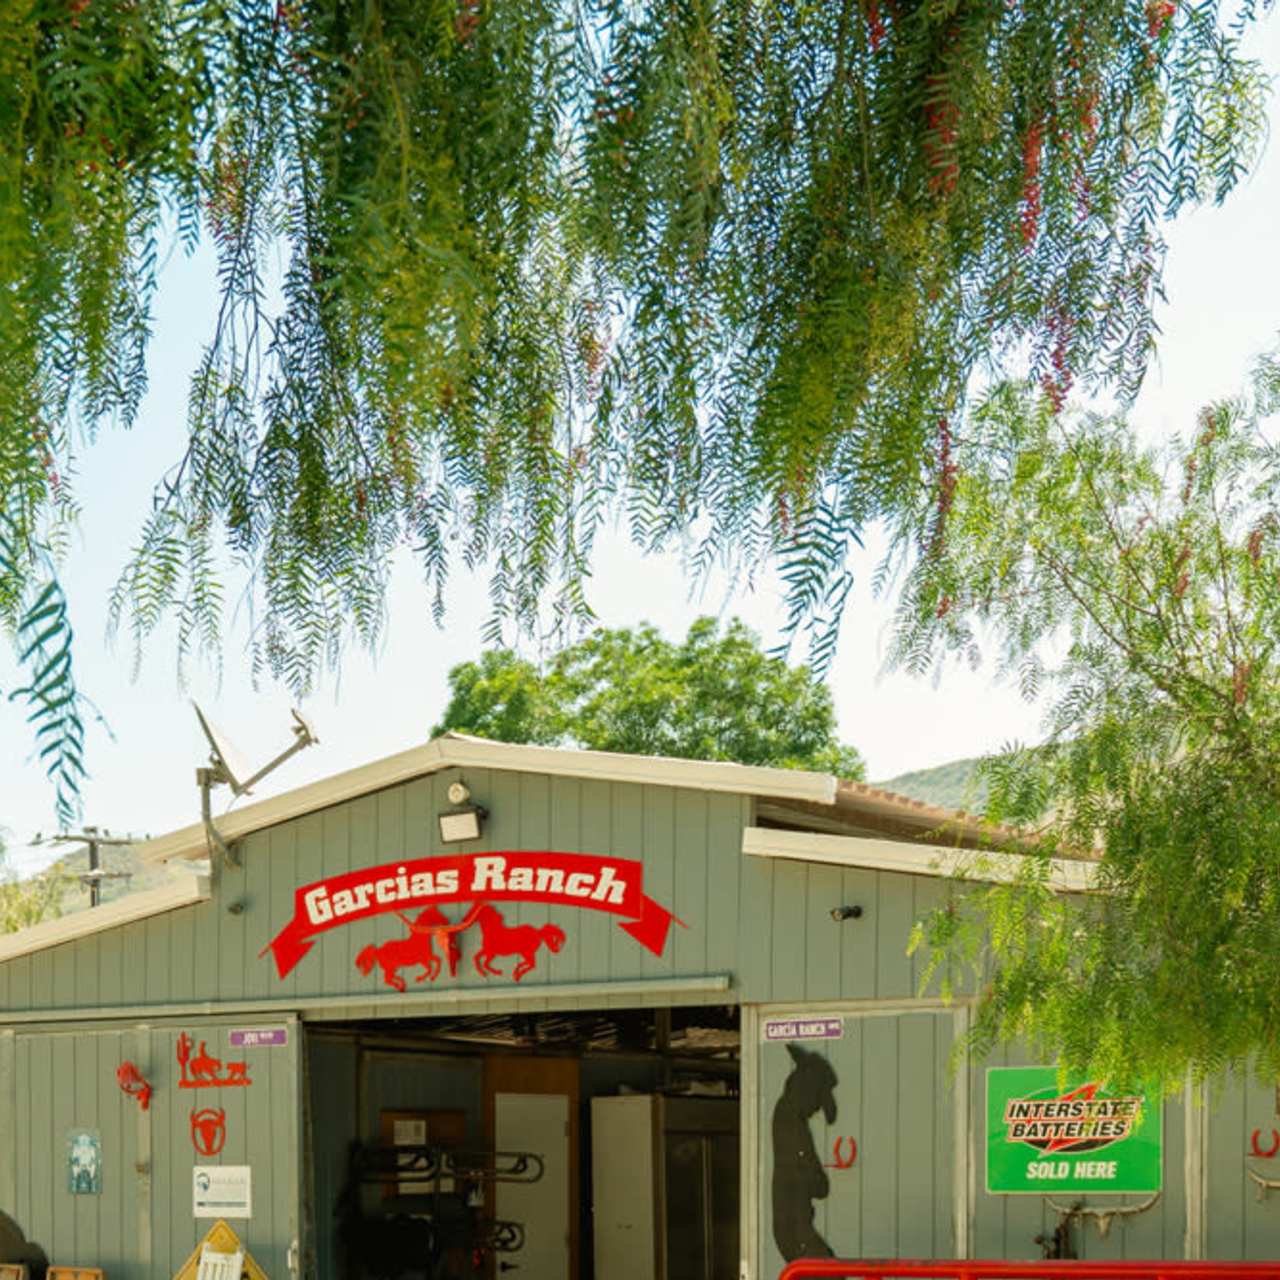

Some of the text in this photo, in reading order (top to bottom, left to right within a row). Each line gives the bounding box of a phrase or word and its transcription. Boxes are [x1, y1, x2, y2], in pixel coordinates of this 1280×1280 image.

[303, 856, 627, 925] Garcias Ranch
[1008, 1101, 1136, 1118] INTERSTATE
[1026, 1161, 1117, 1179] SOLD HERE
